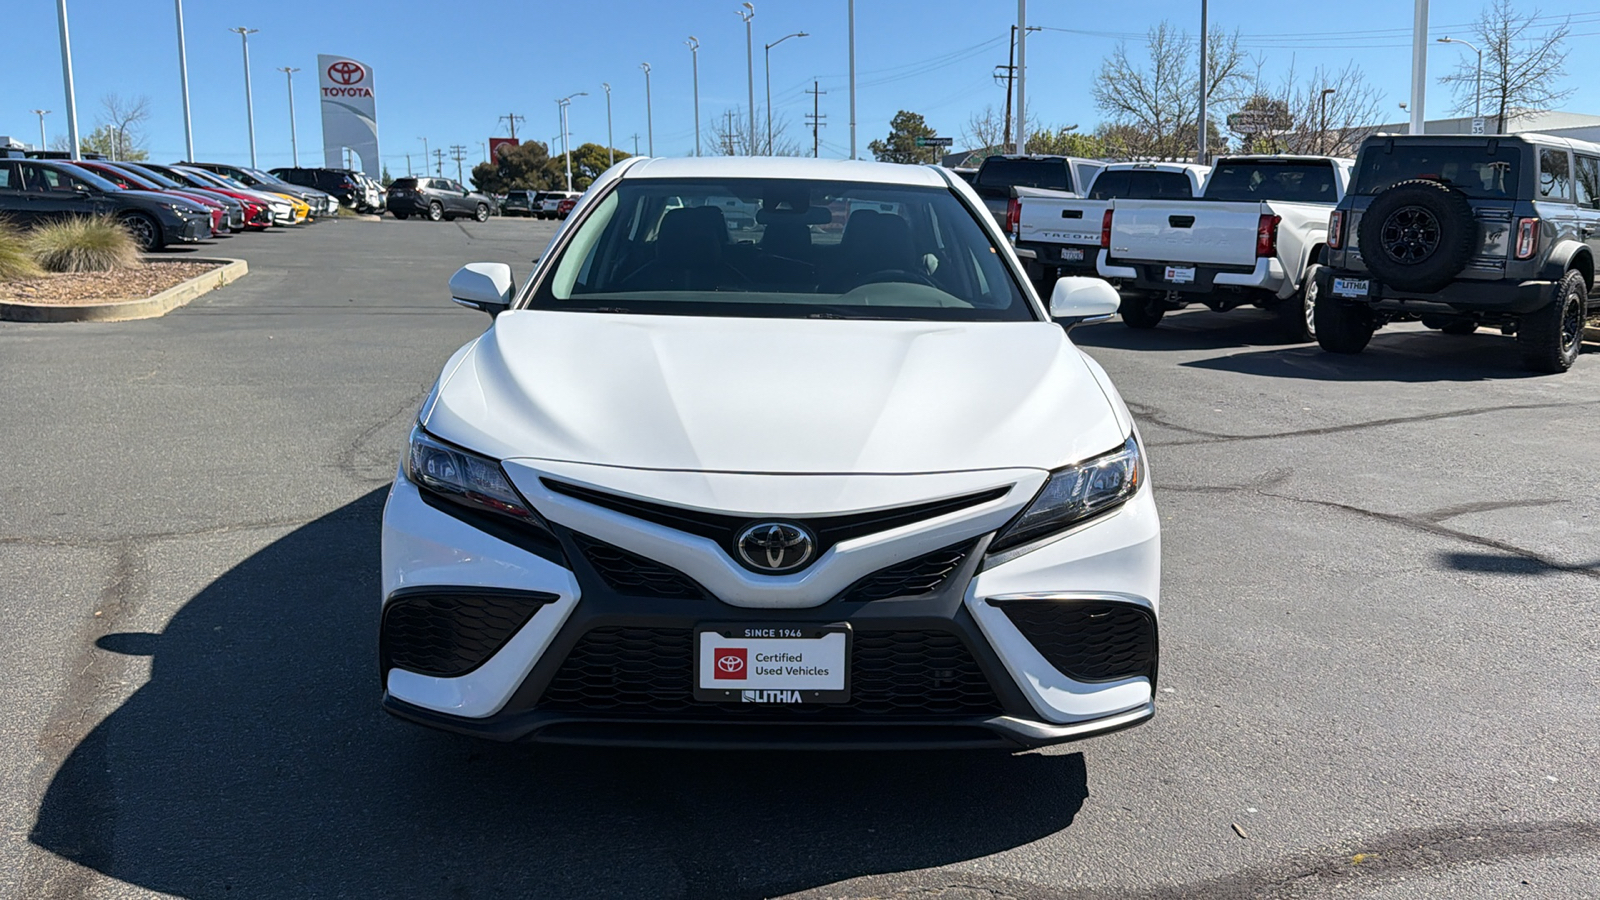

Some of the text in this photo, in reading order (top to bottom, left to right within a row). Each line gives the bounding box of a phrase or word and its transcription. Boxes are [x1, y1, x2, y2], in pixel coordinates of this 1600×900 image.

[321, 87, 373, 97] TOYOTA
[1342, 281, 1367, 290] LITHIA
[744, 629, 802, 637] SINCE 1946
[755, 652, 803, 663] Certified
[755, 666, 829, 676] Used Vehicles
[756, 690, 802, 703] LITHIA
